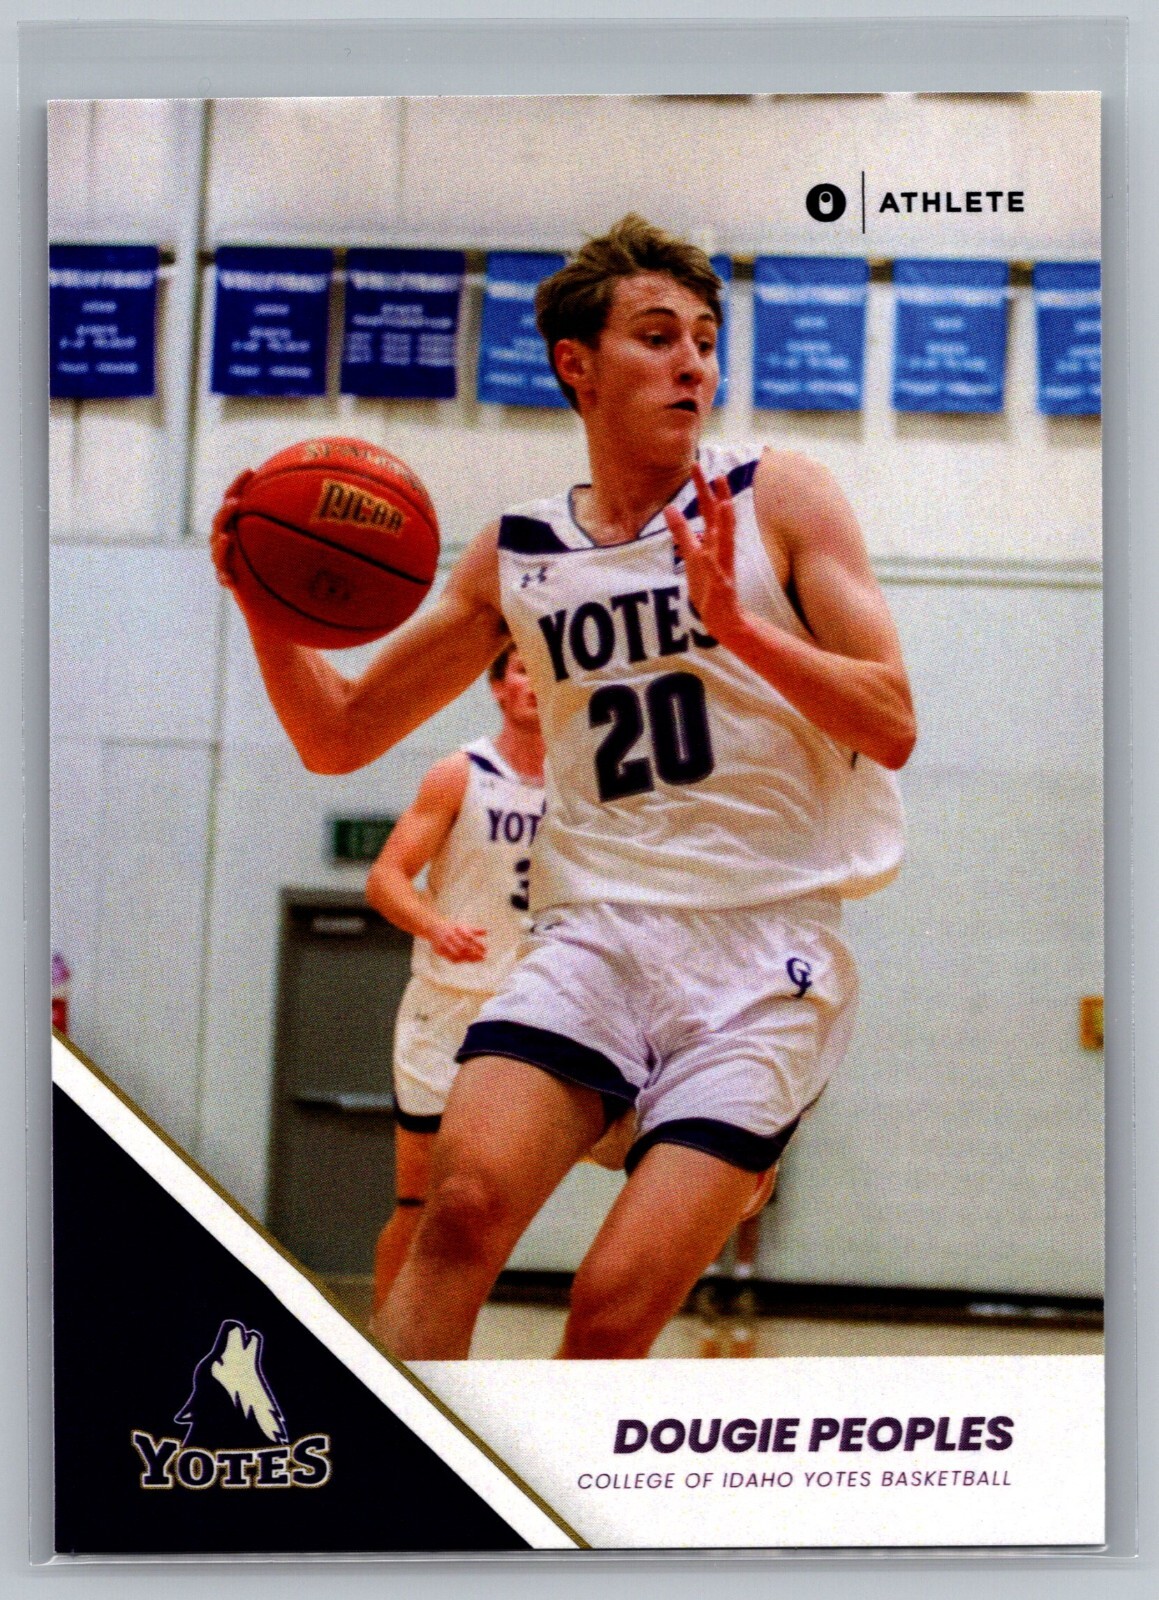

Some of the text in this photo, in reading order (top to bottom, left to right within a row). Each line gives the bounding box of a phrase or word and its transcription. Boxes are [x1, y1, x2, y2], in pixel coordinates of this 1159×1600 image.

[879, 191, 1025, 213] ATHLETE
[588, 671, 715, 803] 20
[613, 1415, 1015, 1455] DOUGIE PEOPLES
[130, 1430, 331, 1489] YOTES
[577, 1469, 1011, 1490] COLLEGE OF IDAHO YOTES BASKETBALL
